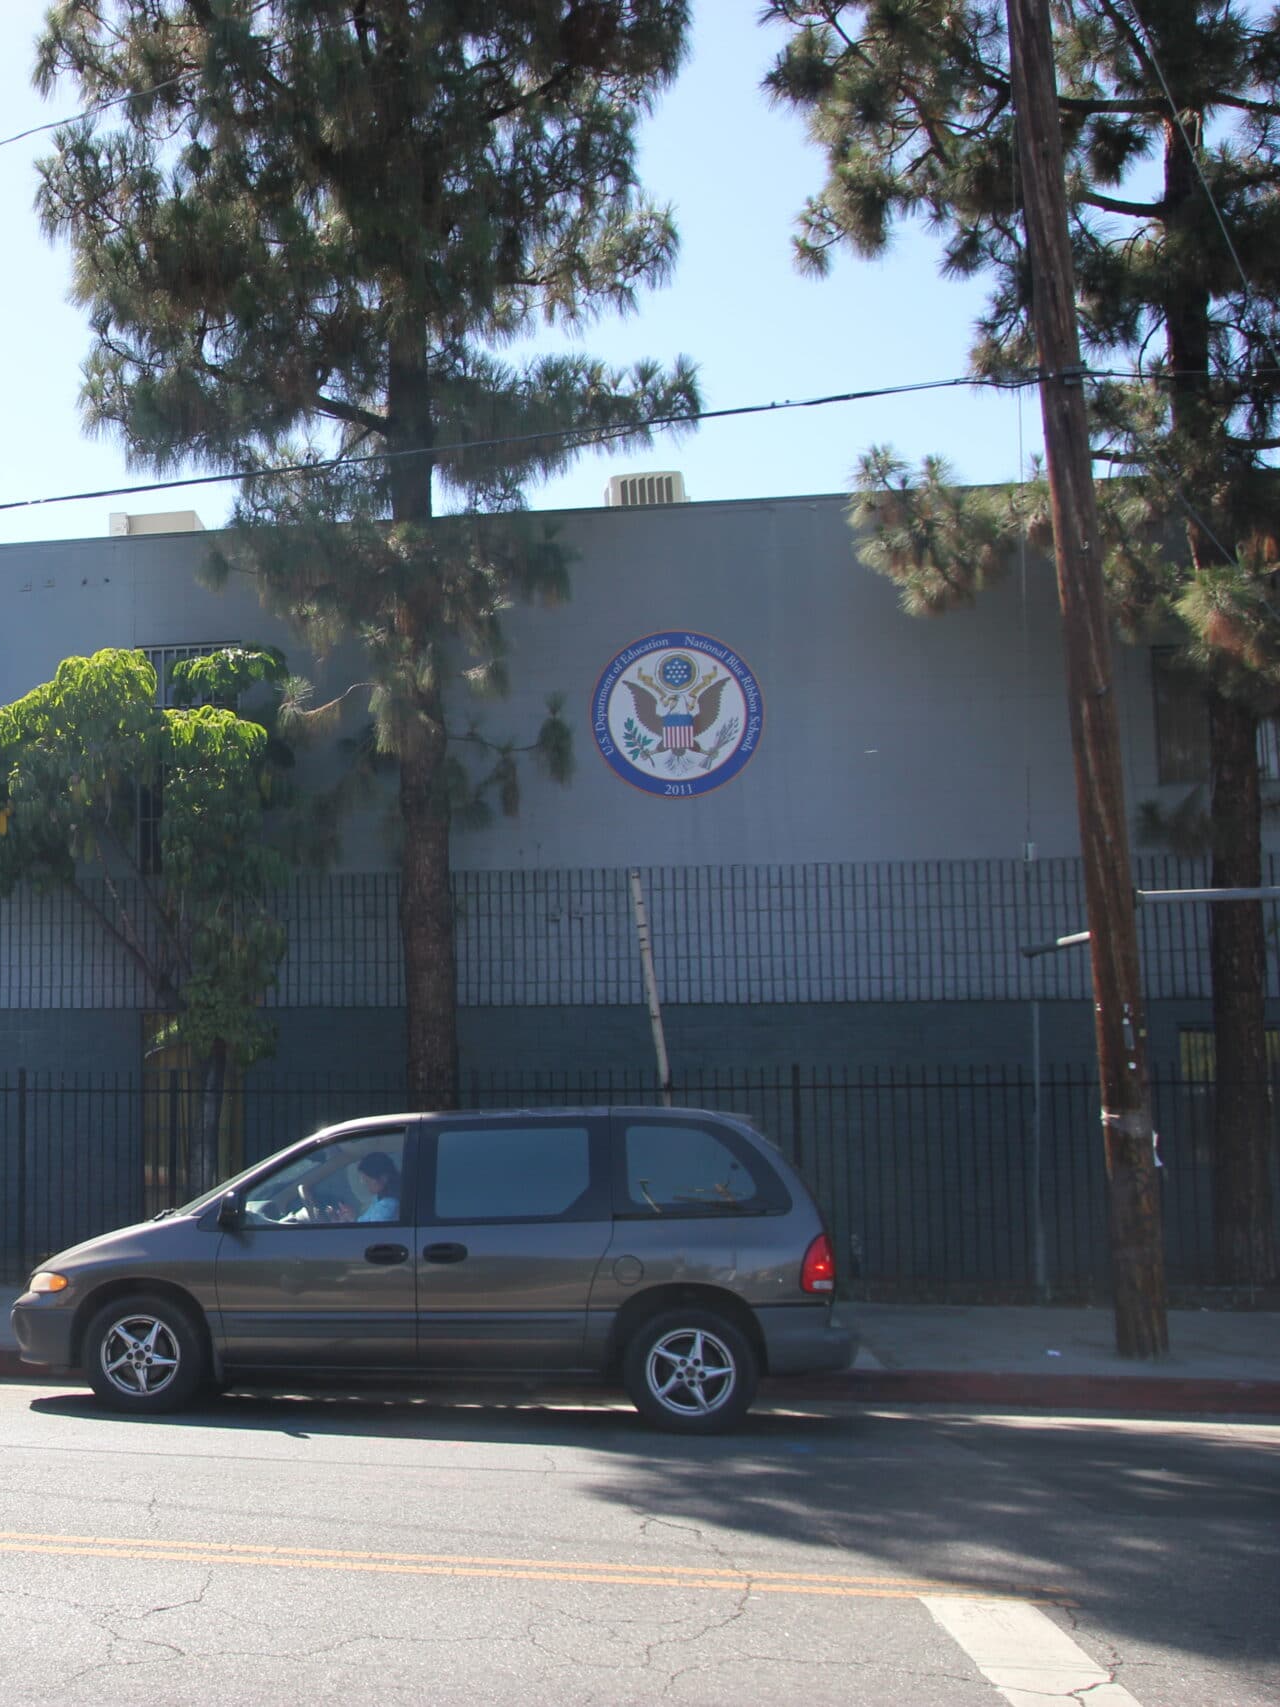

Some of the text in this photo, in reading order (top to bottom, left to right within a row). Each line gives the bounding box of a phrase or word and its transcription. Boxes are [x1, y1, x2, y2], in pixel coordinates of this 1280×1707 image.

[595, 638, 669, 756] U.S. Department of Education
[684, 636, 760, 752] National Blue Ribbon Schools
[664, 784, 694, 796] 2011
